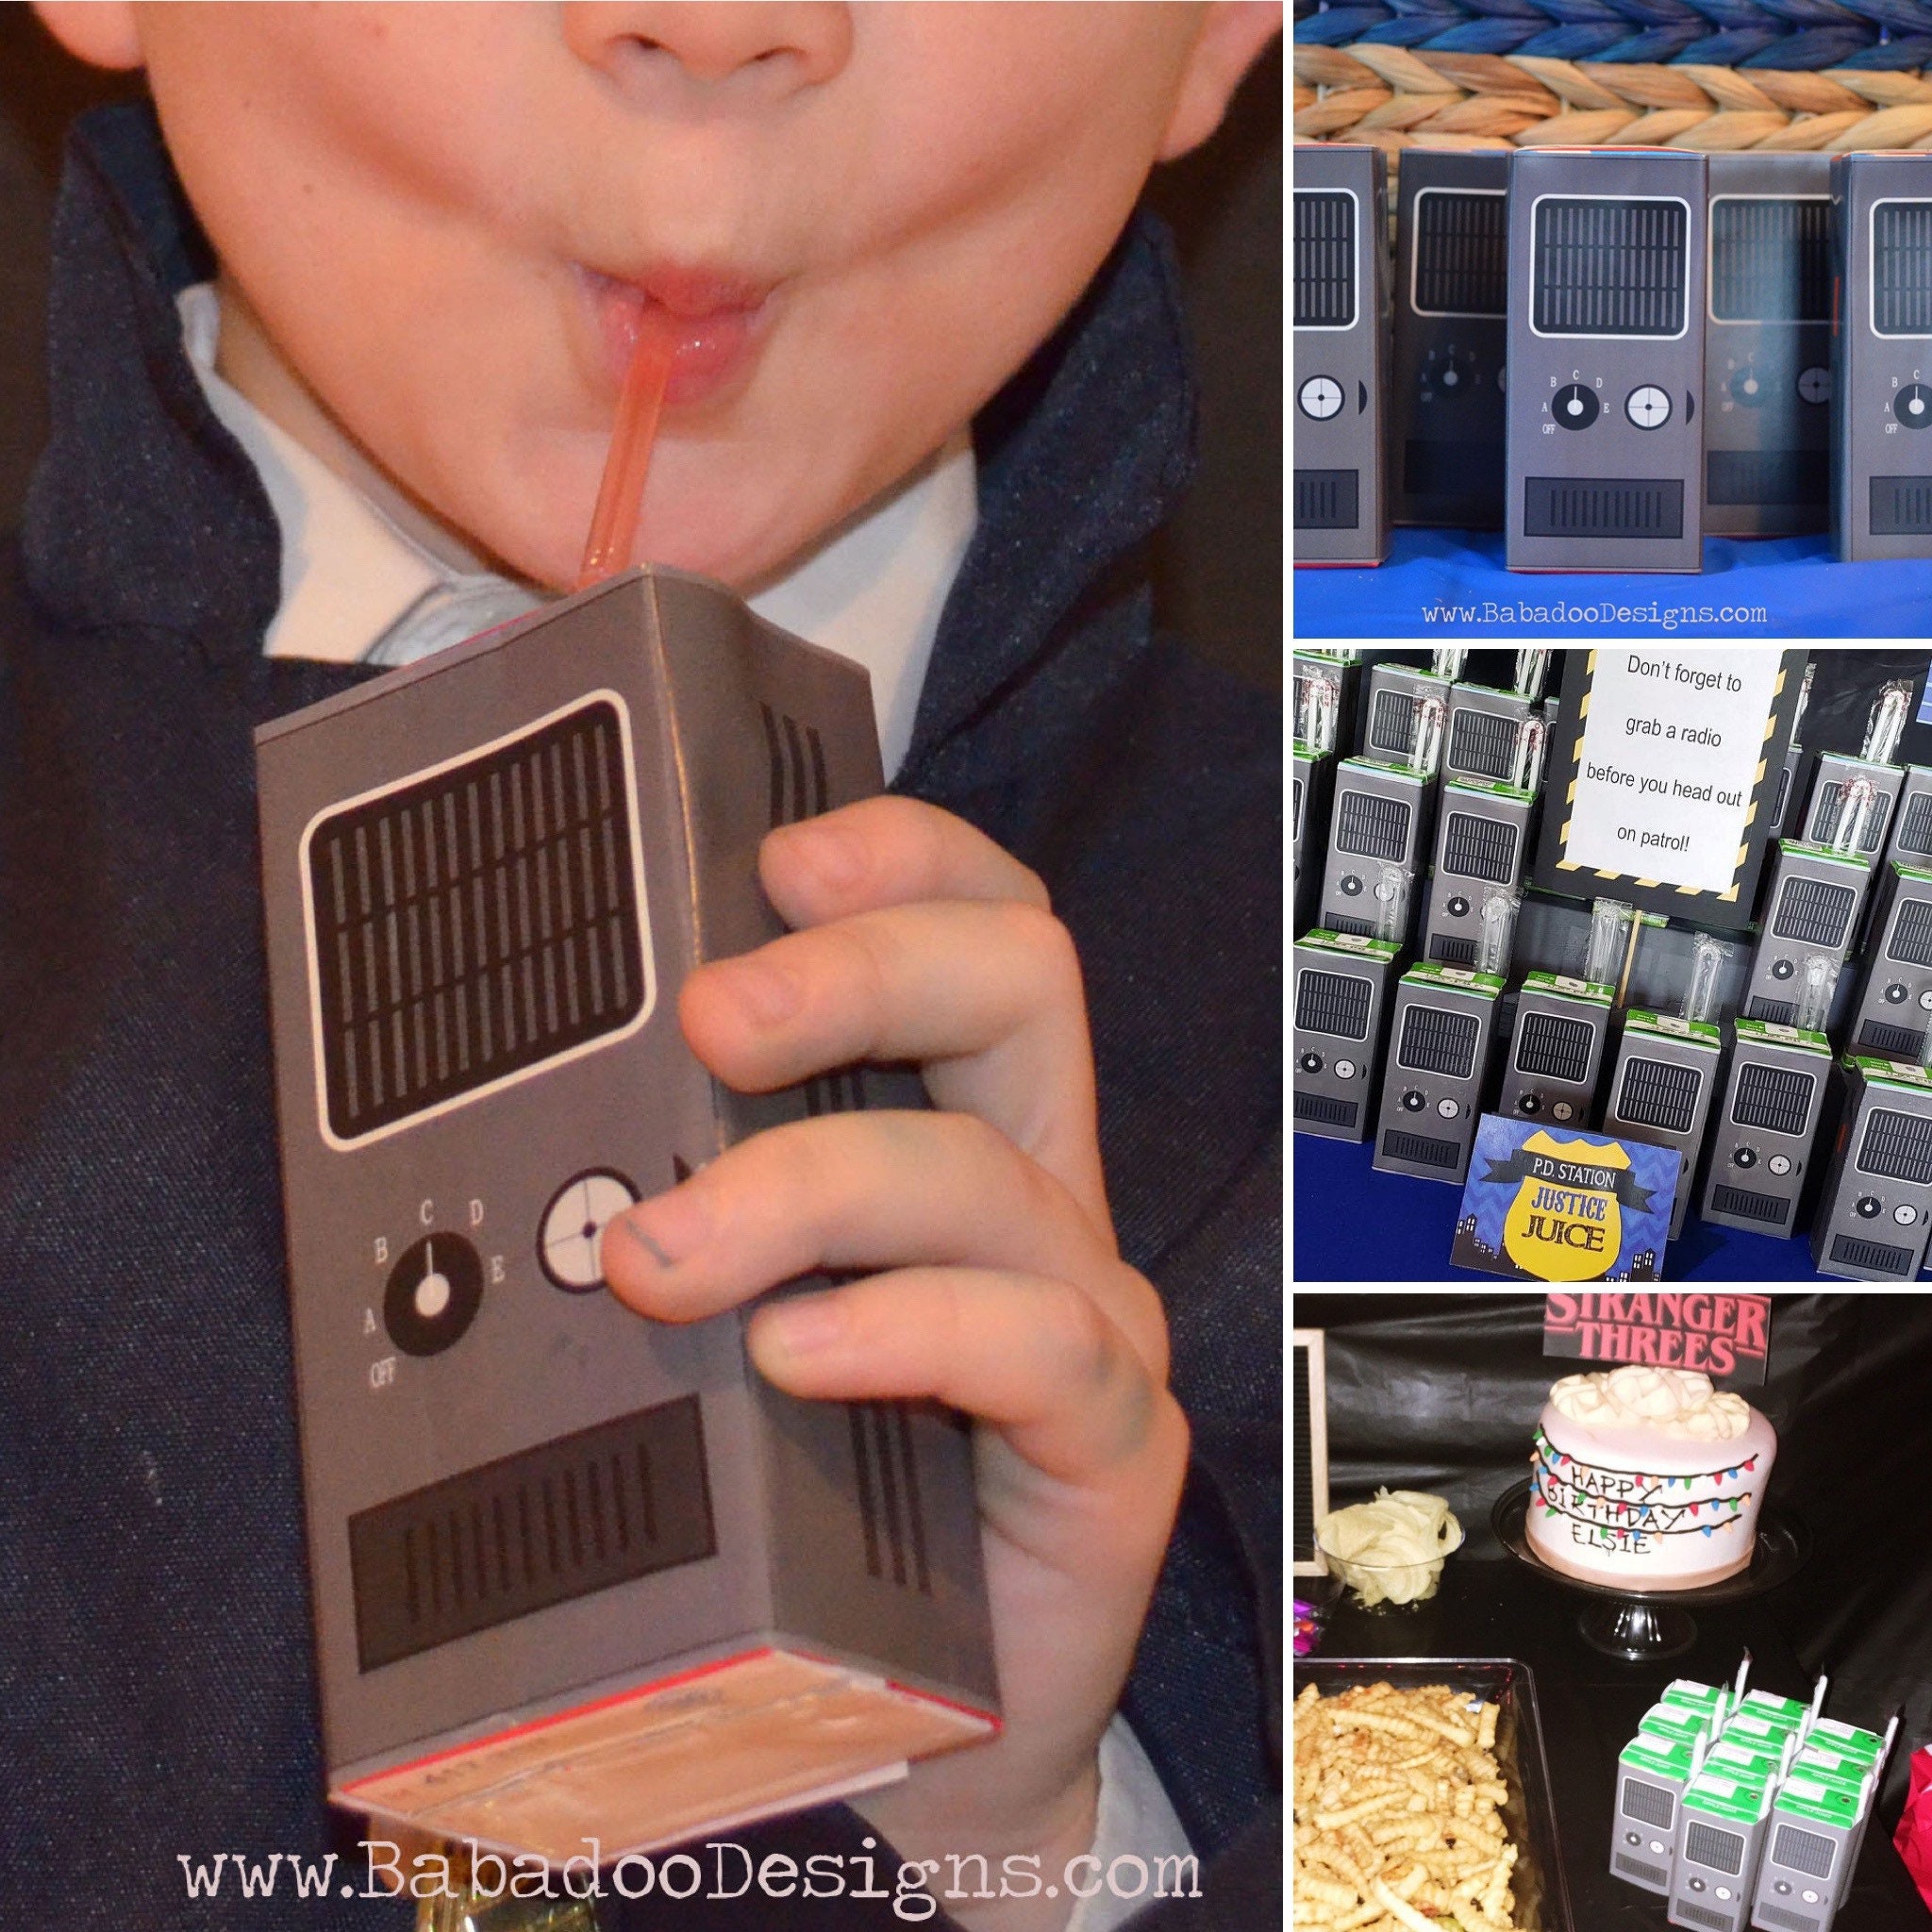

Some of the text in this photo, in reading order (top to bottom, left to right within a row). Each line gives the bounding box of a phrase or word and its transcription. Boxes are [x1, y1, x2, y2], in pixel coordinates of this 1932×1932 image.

[1550, 376, 1557, 388] B
[1573, 369, 1580, 380] C
[1595, 377, 1603, 389] D
[1891, 376, 1898, 388] B
[1913, 369, 1921, 380] C
[1541, 402, 1548, 412] A
[1603, 403, 1610, 413] E
[1883, 402, 1890, 412] A
[1541, 424, 1556, 435] OFF
[1885, 423, 1898, 434] OFF
[1627, 655, 1742, 691] Don't forget to
[1625, 717, 1722, 747] grab a radio
[1587, 761, 1742, 808] before you head out
[1617, 825, 1690, 852] on patrol!
[1532, 1158, 1617, 1189] P.D. STATION
[420, 1198, 434, 1225] C
[469, 1198, 485, 1226] D
[1530, 1186, 1608, 1222] JUSTICE
[1521, 1214, 1606, 1253] JUICE
[374, 1236, 389, 1263] B
[491, 1255, 505, 1284] E
[362, 1307, 376, 1334] A
[1547, 1293, 1767, 1349] STRANGER
[1575, 1321, 1736, 1375] THREES
[369, 1356, 397, 1389] OFF
[1572, 1465, 1663, 1503] HAPPY
[1547, 1487, 1687, 1531] BIRTHDAY
[1572, 1523, 1652, 1556] ELSIE
